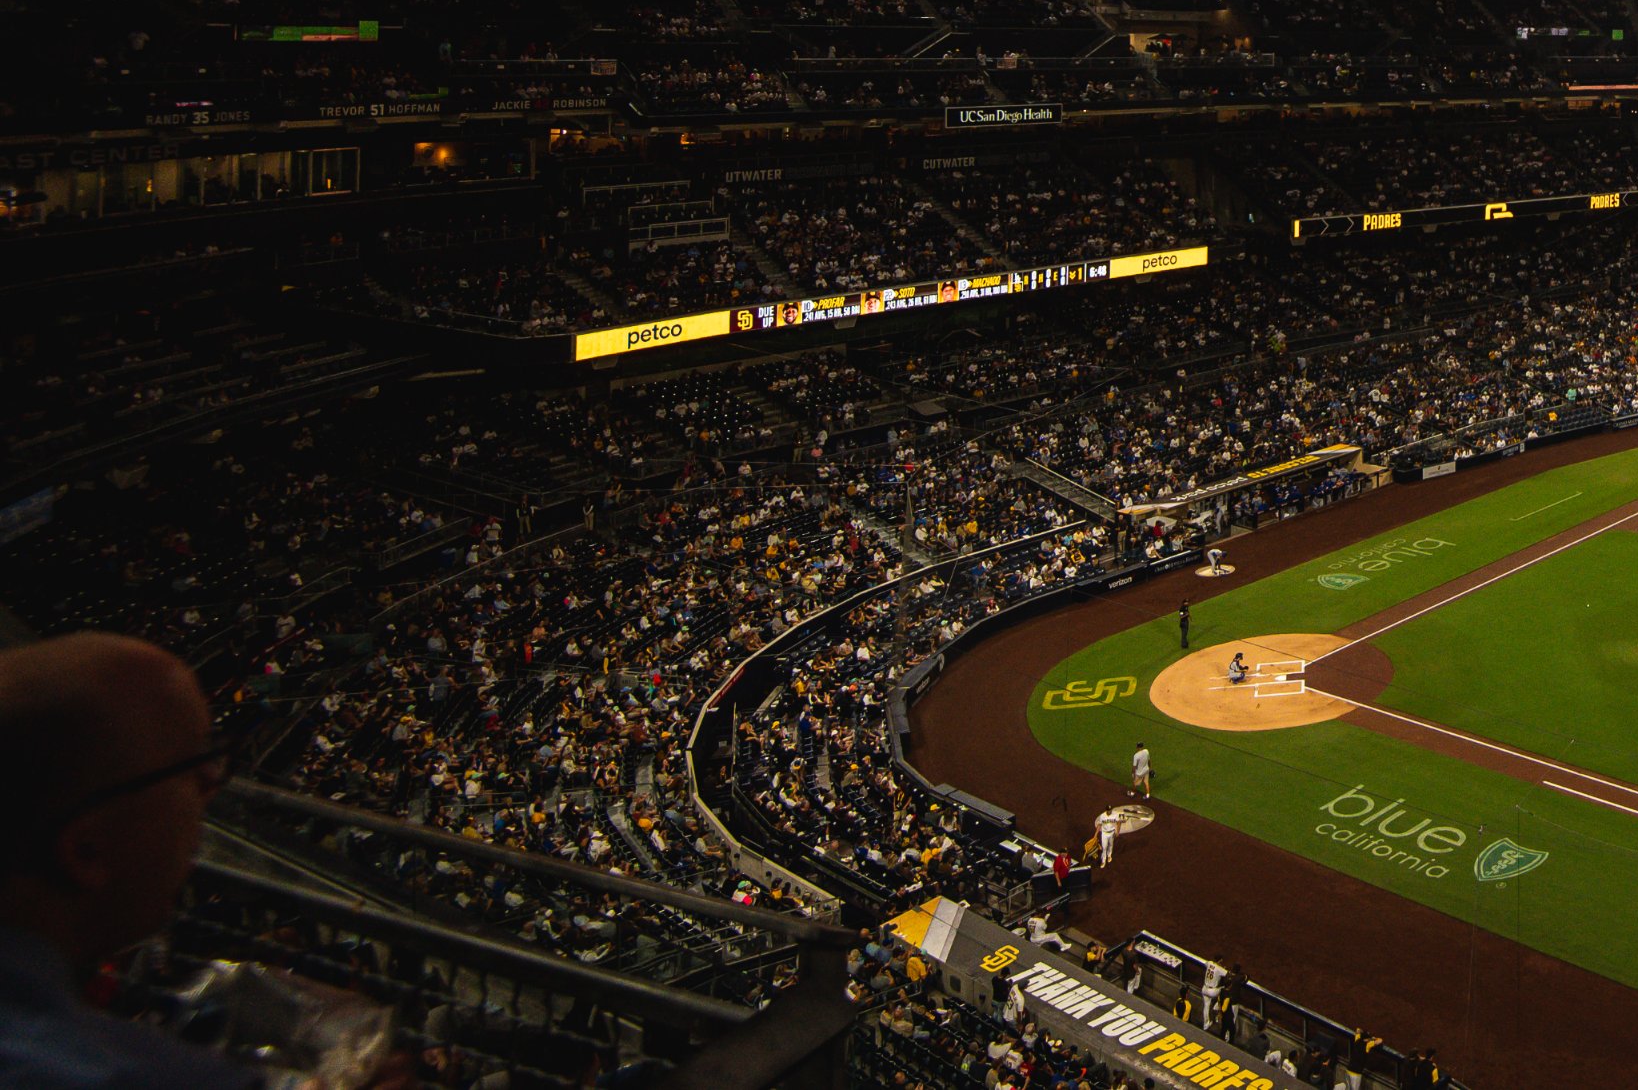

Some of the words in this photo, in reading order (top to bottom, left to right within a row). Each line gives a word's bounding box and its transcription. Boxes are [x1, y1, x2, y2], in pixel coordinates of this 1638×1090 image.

[320, 105, 366, 118] TREVOR
[371, 104, 385, 117] 51
[388, 103, 441, 116] HOFFMAN
[491, 99, 532, 111] JACKIE
[552, 97, 607, 109] ROBINSON
[146, 112, 188, 127] RANDY
[193, 110, 209, 124] 35
[213, 110, 251, 124] JONES
[960, 110, 976, 123] UC
[977, 110, 995, 122] San
[996, 109, 1023, 124] Diego
[1023, 107, 1053, 121] Health
[69, 143, 181, 166] CENTER
[923, 154, 977, 171] CUTWATER
[726, 168, 784, 184] UTWATER
[1591, 192, 1620, 209] PADRES
[1363, 213, 1401, 231] PADRES
[1142, 253, 1179, 272] petco
[972, 275, 1002, 289] MACHADO
[898, 287, 916, 298] SOTO
[817, 296, 846, 310] PROFAR
[758, 306, 775, 318] DUE
[763, 317, 775, 328] UP
[628, 322, 683, 350] petco
[1358, 537, 1457, 572] blue
[1109, 576, 1134, 589] verizon
[1319, 784, 1467, 854] blue
[1315, 823, 1451, 878] california
[1007, 961, 1116, 1021] THANK
[1087, 1003, 1168, 1047] YOU
